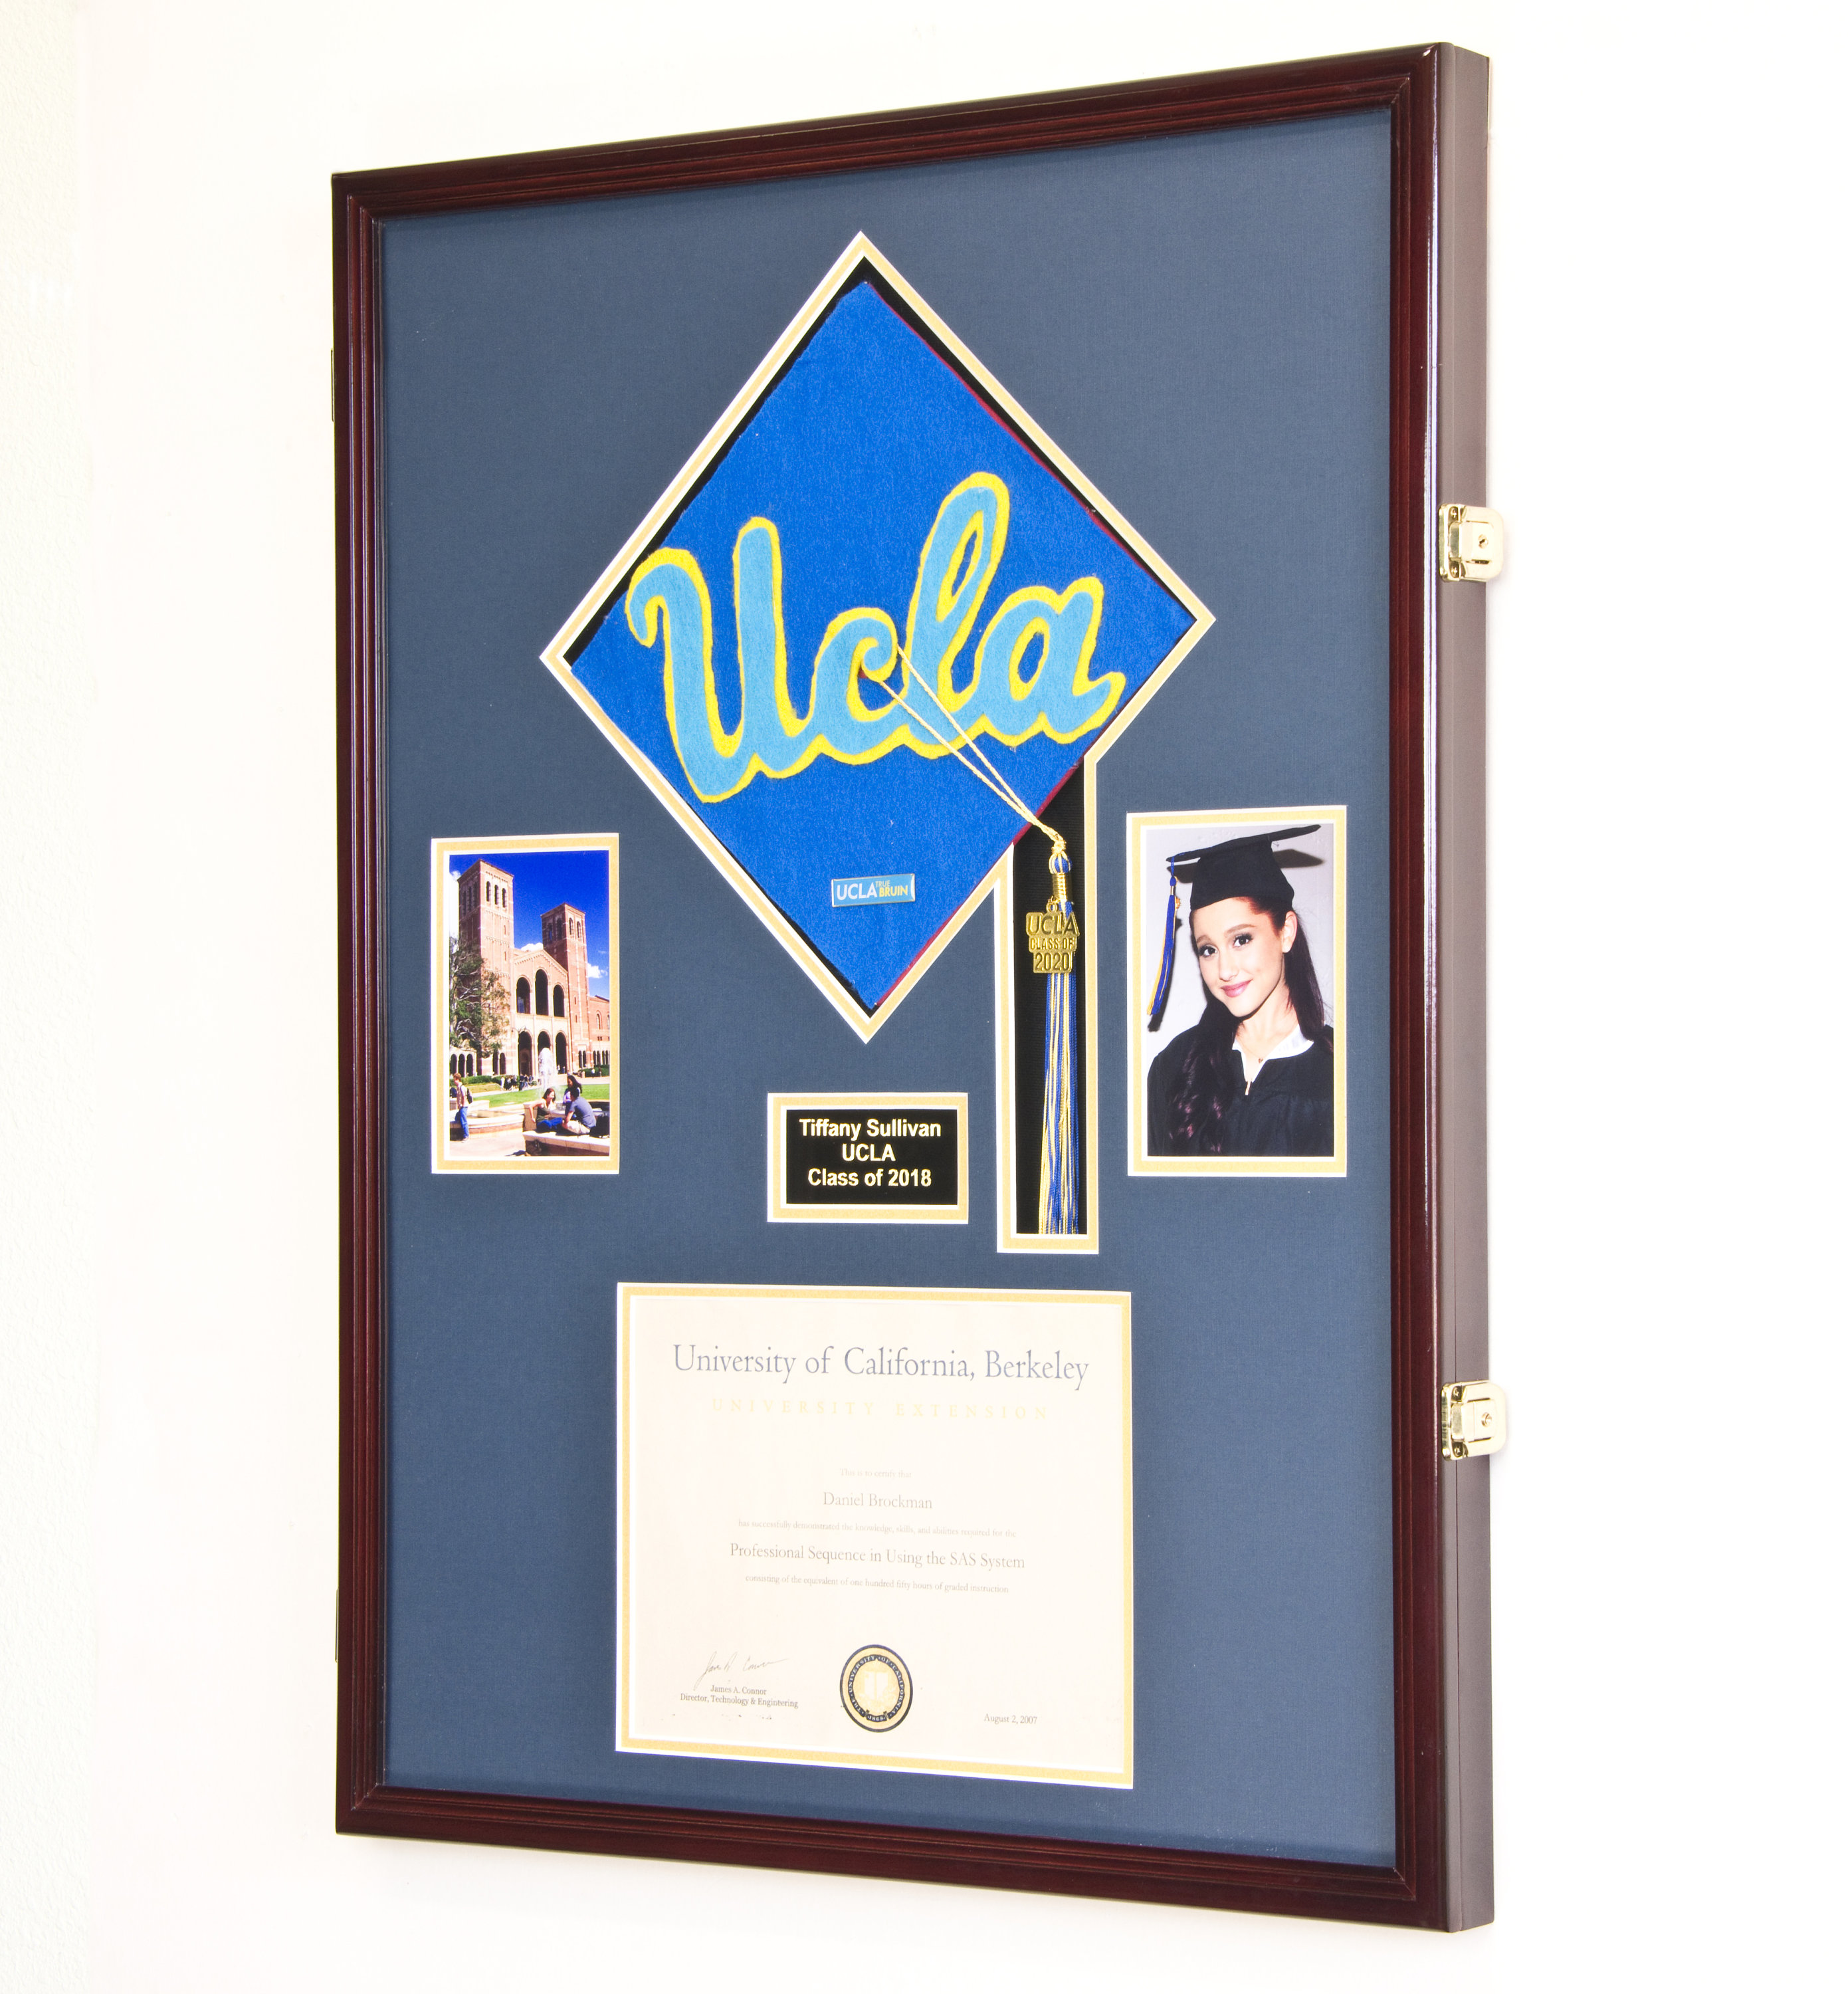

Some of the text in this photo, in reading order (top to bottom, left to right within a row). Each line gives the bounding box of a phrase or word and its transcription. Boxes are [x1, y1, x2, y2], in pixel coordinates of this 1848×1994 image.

[625, 471, 1126, 804] Ucla
[837, 881, 877, 901] UCLA
[879, 885, 908, 897] BRUIN
[1027, 913, 1080, 936] UCLA
[1030, 937, 1075, 950] CLASS OF
[1034, 952, 1071, 970] 2020
[799, 1119, 942, 1141] Tiffany Sullivan
[842, 1143, 896, 1162] UCLA
[808, 1168, 932, 1187] Class of 2018
[673, 1344, 1089, 1391] University of California, Berkeley
[712, 1398, 1048, 1420] UNIVERSITY EXTENSION
[823, 1491, 933, 1509] Daniel Brockman
[738, 1517, 750, 1527] has
[752, 1519, 792, 1531] successfully
[793, 1520, 839, 1531] demonstrated
[841, 1521, 853, 1531] the
[917, 1526, 930, 1535] and
[932, 1526, 959, 1535] abilities
[961, 1528, 990, 1540] required
[993, 1529, 1003, 1537] for
[1005, 1529, 1017, 1538] the
[730, 1542, 1025, 1571] Professional Sequence in Using the SAS System
[745, 1574, 780, 1585] consisting
[781, 1575, 789, 1584] of
[791, 1575, 801, 1584] the
[803, 1577, 838, 1587] equivalent
[840, 1577, 849, 1586] of
[865, 1578, 894, 1589] hundred
[896, 1579, 910, 1591] fifty
[913, 1581, 932, 1591] hours
[934, 1581, 943, 1591] of
[944, 1583, 968, 1593] graded
[970, 1583, 1009, 1594] instruction
[710, 1684, 732, 1694] James
[742, 1686, 766, 1696] Connor
[680, 1692, 709, 1703] Director,
[710, 1694, 749, 1706] Technology
[758, 1697, 798, 1709] Engineering
[984, 1713, 1037, 1725] August 2, 2007
